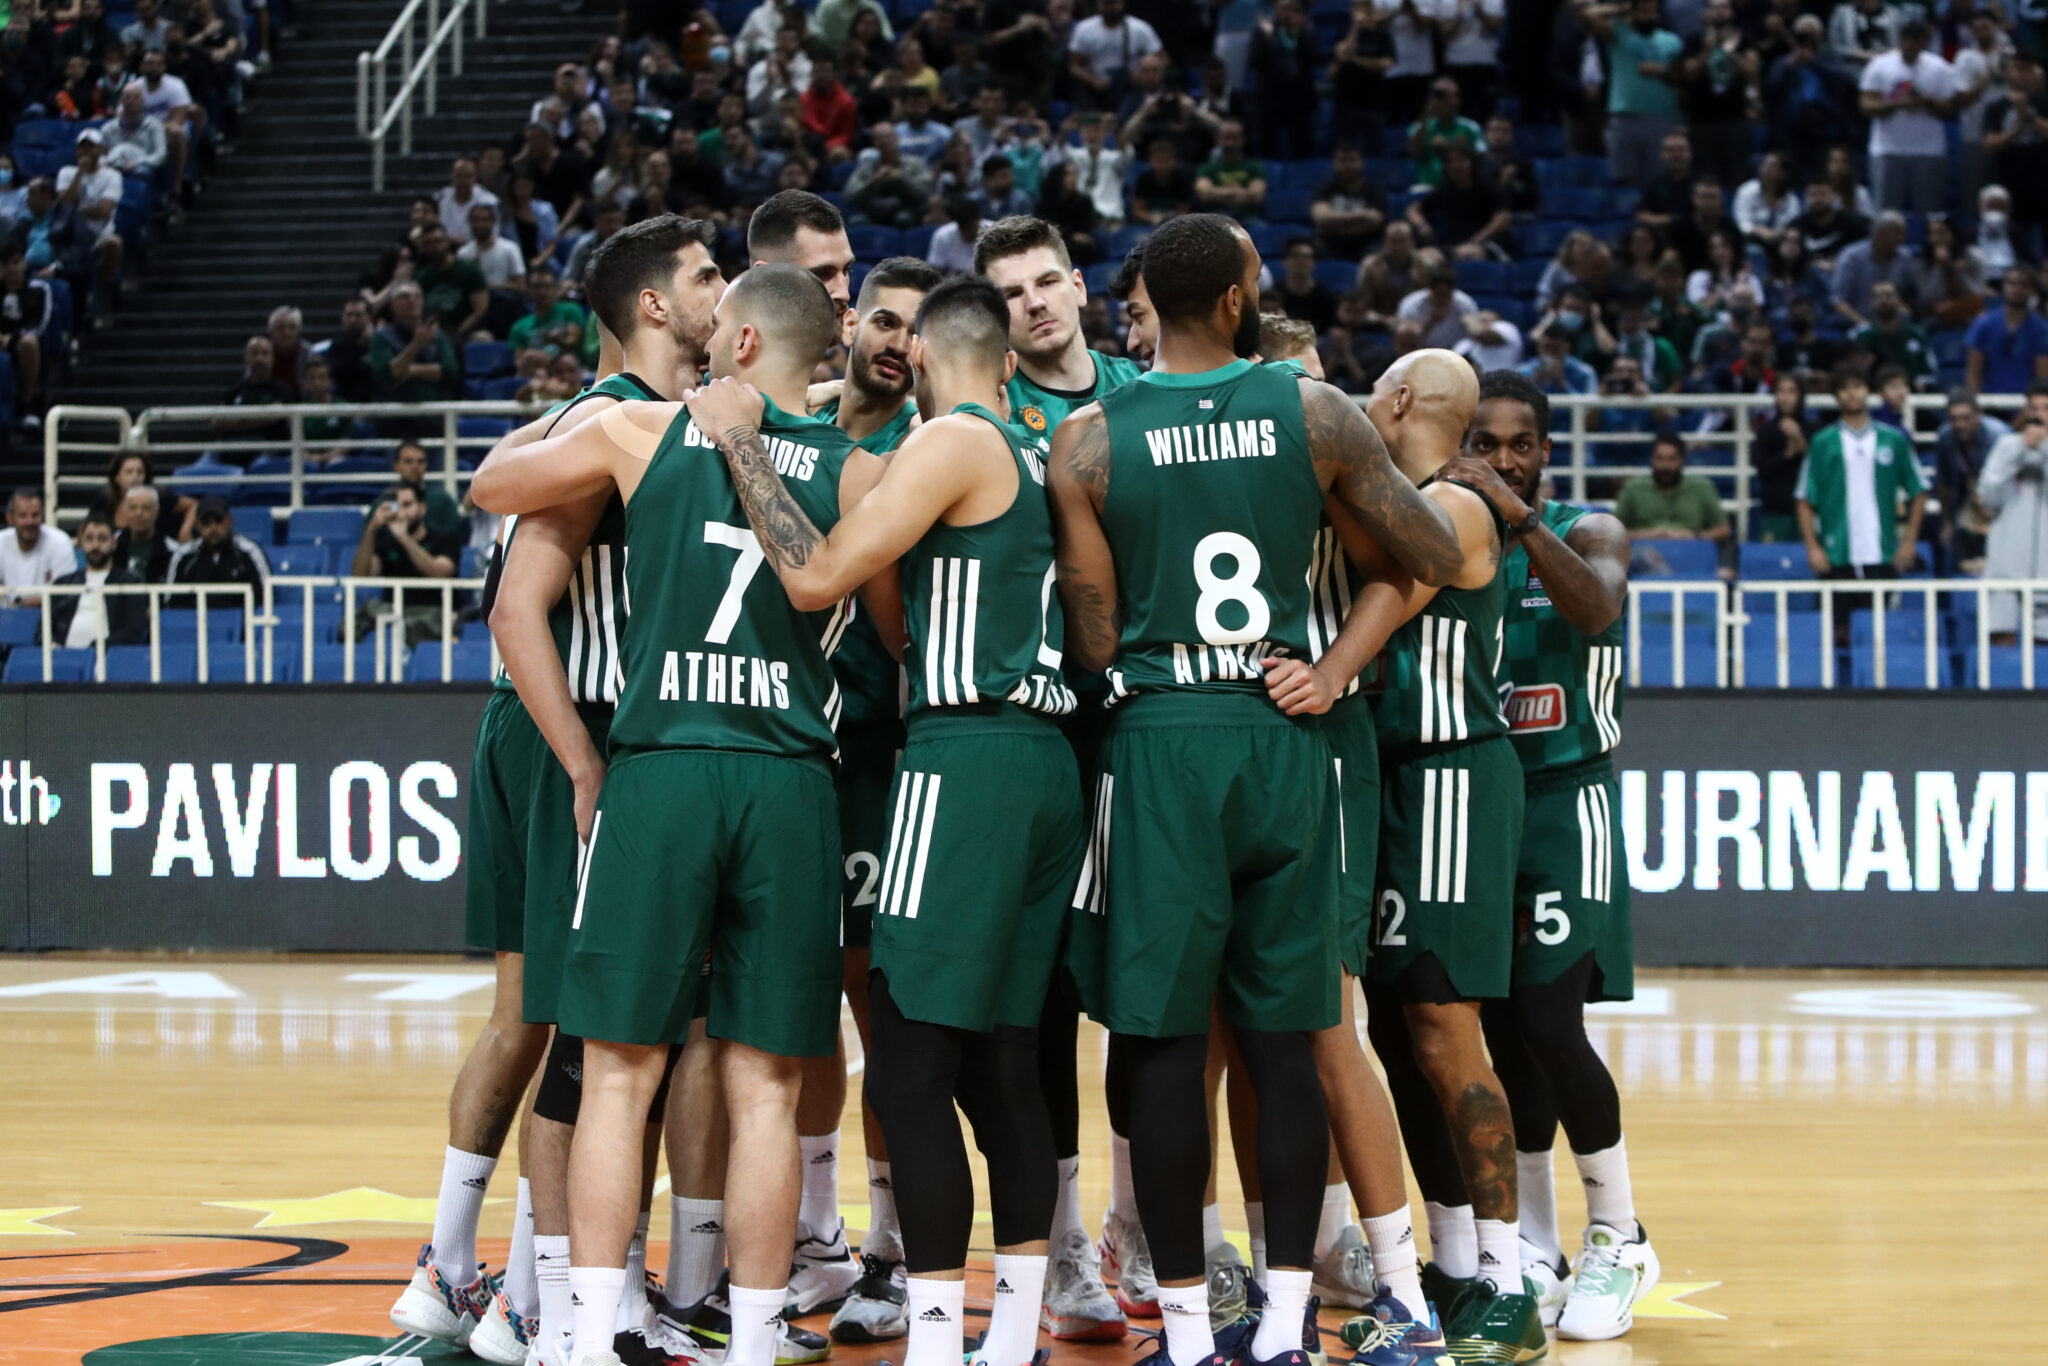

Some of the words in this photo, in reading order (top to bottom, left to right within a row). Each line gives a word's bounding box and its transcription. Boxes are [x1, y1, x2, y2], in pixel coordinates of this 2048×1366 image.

[1145, 419, 1277, 467] WILLIAMS
[704, 521, 765, 645] 7
[1193, 531, 1270, 646] 8
[659, 651, 790, 709] ATHENS
[91, 760, 462, 881] PAVLOS
[1535, 890, 1571, 946] 5
[919, 1315, 951, 1323] adidas
